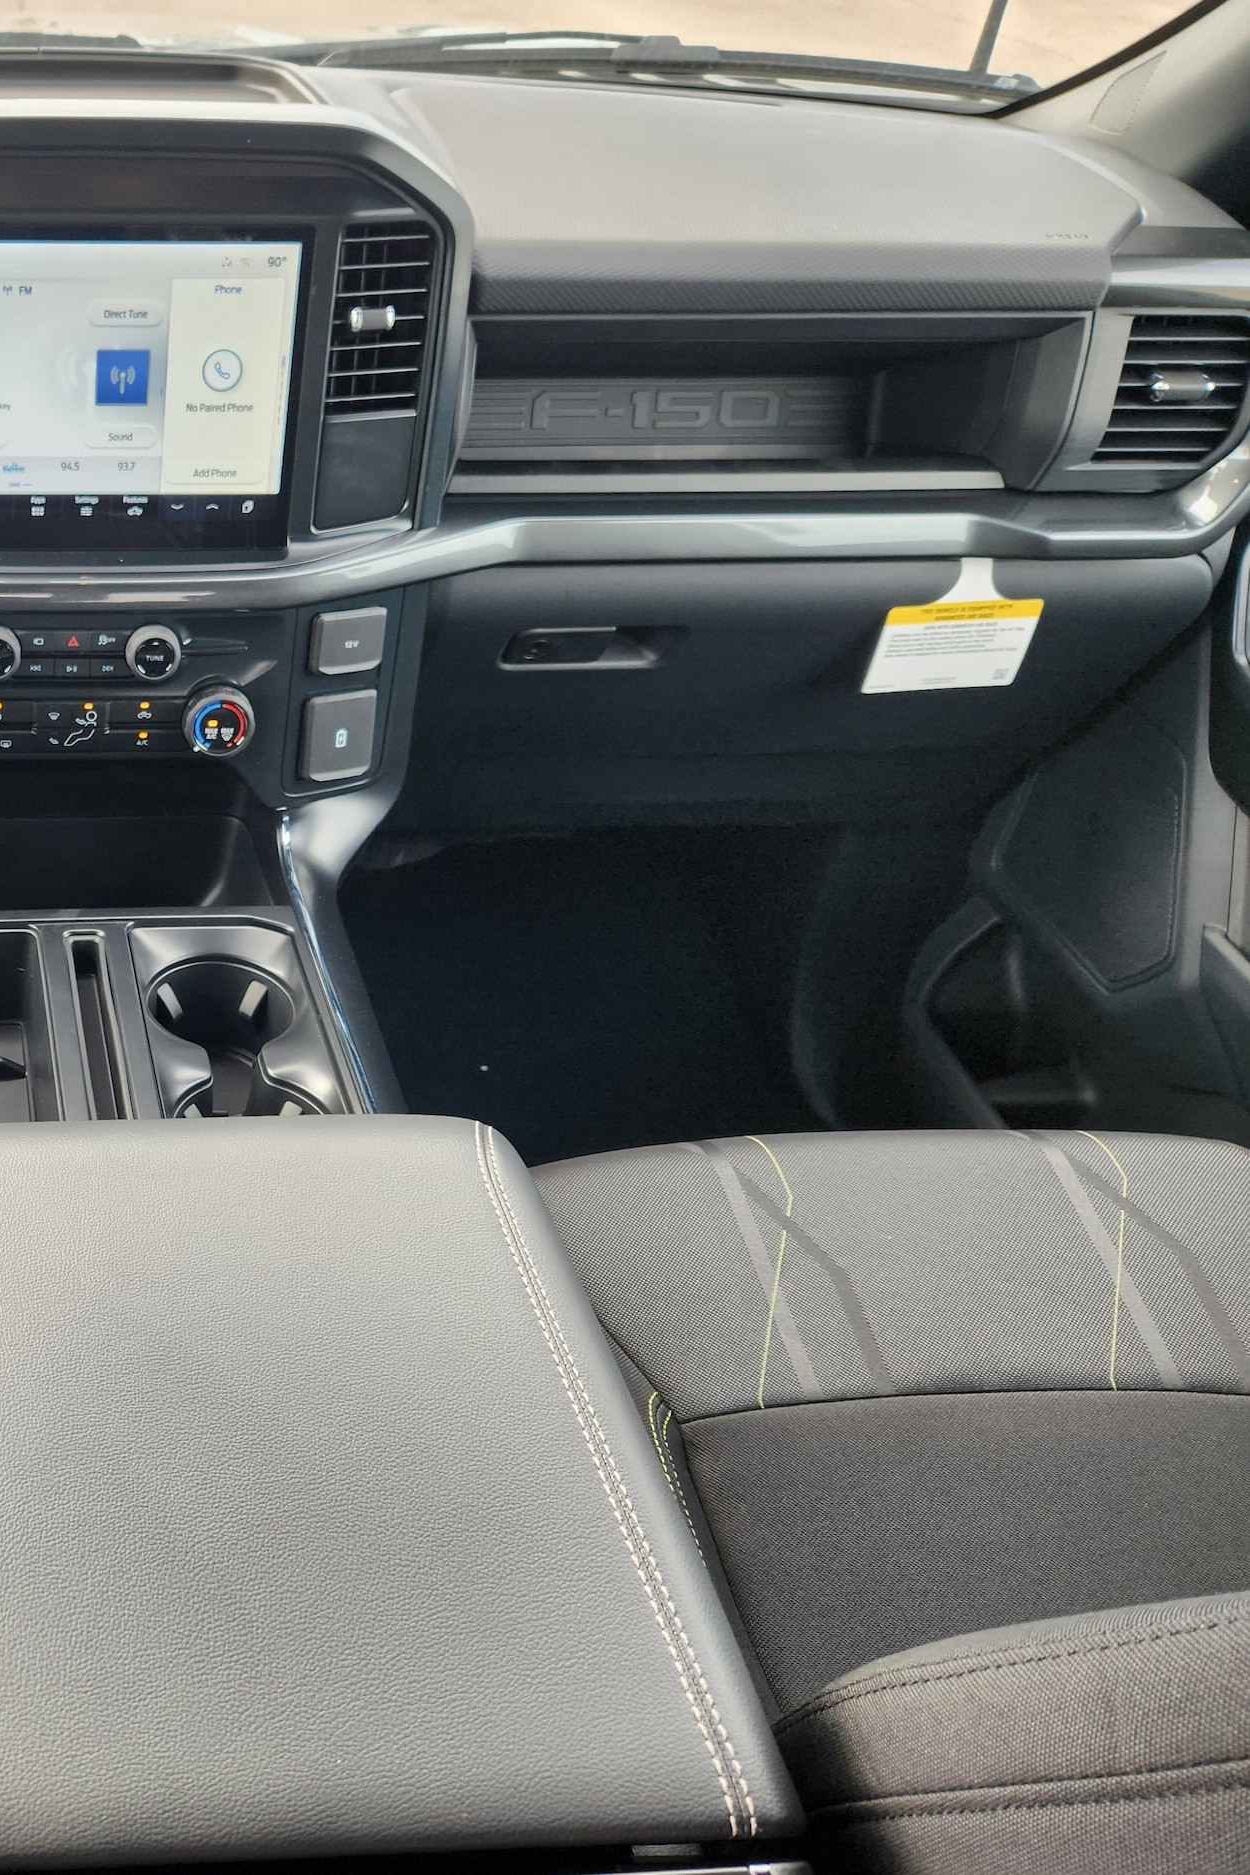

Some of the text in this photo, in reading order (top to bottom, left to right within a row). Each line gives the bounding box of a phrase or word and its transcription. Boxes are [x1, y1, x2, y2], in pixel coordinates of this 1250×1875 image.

[18, 286, 33, 295] FM
[214, 285, 243, 295] Phone
[103, 310, 148, 319] Direct Tune
[186, 403, 254, 413] No Paired Phone
[530, 390, 781, 429] F-150
[108, 433, 133, 442] Sound
[61, 462, 80, 471] 94.5
[117, 462, 135, 471] 93.7
[193, 469, 237, 478] Add Phone
